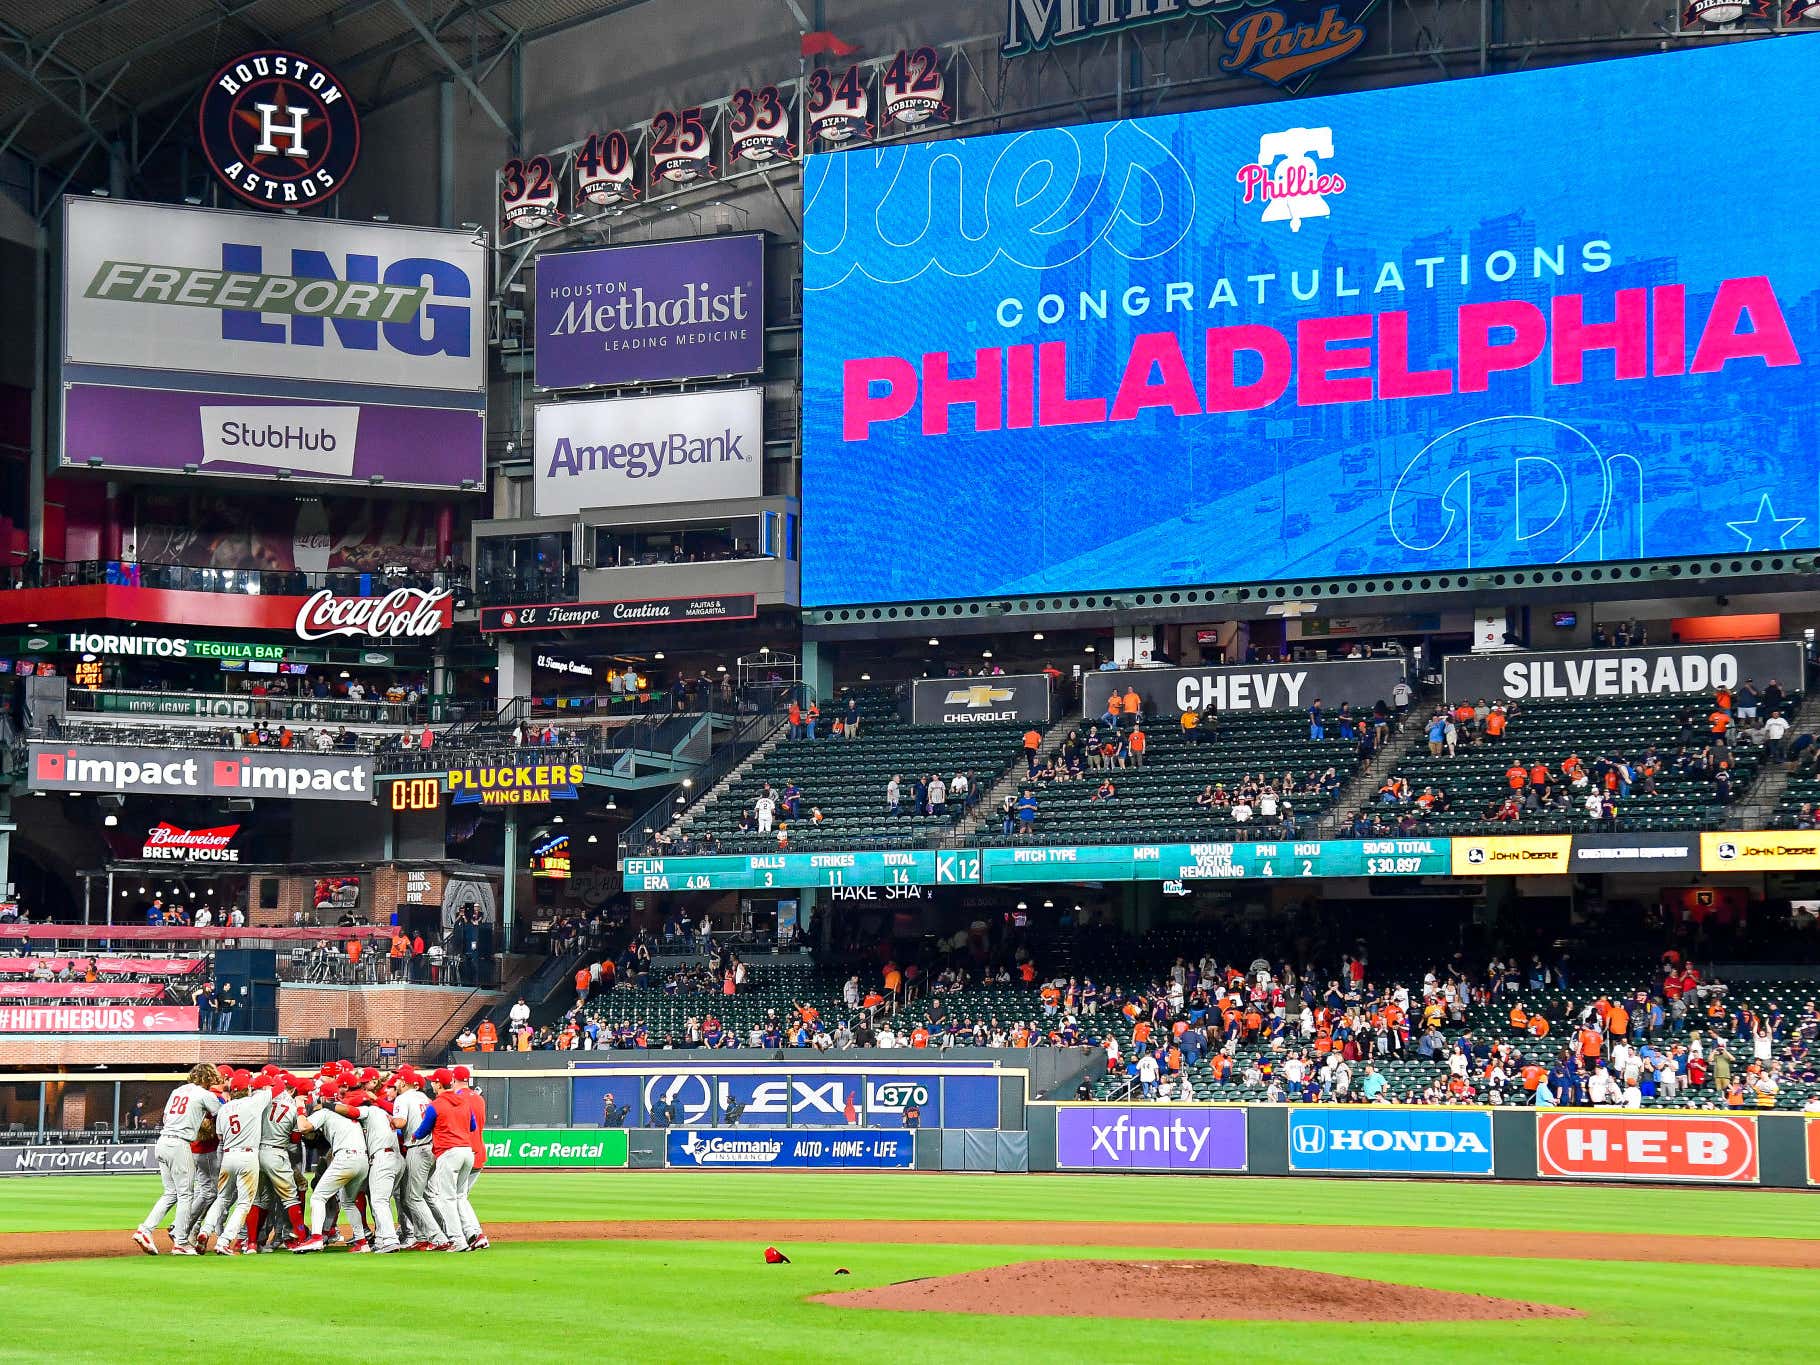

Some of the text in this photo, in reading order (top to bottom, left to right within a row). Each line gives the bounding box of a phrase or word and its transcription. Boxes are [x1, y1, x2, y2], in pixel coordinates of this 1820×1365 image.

[1222, 8, 1364, 80] Park
[219, 57, 342, 104] HOUSTON
[883, 46, 940, 96] 42
[807, 64, 862, 113] 34
[729, 86, 782, 133] 33
[254, 101, 309, 158] H
[650, 106, 705, 155] 25
[575, 130, 629, 178] 40
[225, 161, 334, 201] ASTROS
[502, 154, 552, 203] 32
[1236, 164, 1346, 203] Phillies
[97, 264, 418, 319] FREEPORT
[550, 281, 627, 298] HOUSTON
[996, 240, 1613, 328] CONGRATULATIONS
[222, 243, 471, 358] LNG
[550, 282, 749, 337] Methodist
[604, 329, 748, 352] LEADING MEDICINE
[843, 275, 1802, 442] PHILADELPHIA
[221, 421, 337, 452] StubHub
[295, 587, 454, 641] Coca-Cola
[520, 603, 671, 625] El Tiempo Cantina
[685, 607, 726, 616] MARGARITAS
[690, 601, 715, 609] FAJITAS
[70, 633, 284, 658] HORNITOS TEQUILA BAR
[1503, 653, 1738, 699] SILVERADO
[1176, 672, 1308, 712] CHEVY
[943, 711, 1018, 723] CHEVROLET
[66, 749, 198, 788] impact
[240, 756, 367, 795] impact
[448, 764, 585, 790] PLUCKERS
[392, 780, 437, 810] 0:00
[482, 789, 550, 804] WING BAR
[149, 827, 229, 847] Budweiser
[1363, 841, 1435, 854] 50/50 TOTAL
[143, 846, 239, 862] BREW HOUSE
[1014, 847, 1160, 862] PITCH TYPE MPH
[1190, 843, 1234, 856] MOUND
[1256, 843, 1320, 857] PHI HOU
[1489, 850, 1558, 861] JOHN DEERE
[1742, 845, 1816, 857] JOHN DEERE
[628, 860, 664, 874] EFLIN
[751, 853, 916, 869] BALLS STRIKES TOTAL
[937, 857, 980, 882] K 12
[1180, 865, 1245, 878] REMAINING
[1196, 856, 1232, 867] VISITS
[1262, 860, 1313, 876] 4 2
[408, 872, 425, 881] THIS
[643, 875, 711, 889] ERA 4.04
[764, 869, 909, 886] 3 11 14
[407, 892, 423, 902] FOR
[0, 1008, 135, 1030] #HITTHEBUDS
[169, 1095, 189, 1115] 28
[885, 1086, 928, 1106] 370
[269, 1101, 290, 1124] 17
[229, 1114, 241, 1135] 5
[709, 1137, 781, 1154] Germania
[1091, 1114, 1211, 1162] xfinity
[1329, 1129, 1489, 1153] HONDA
[1565, 1128, 1730, 1166] H-E-B
[16, 1149, 150, 1169] NITTOTIRE.COM
[518, 1142, 547, 1158] Car
[551, 1142, 604, 1158] Rental
[714, 1153, 770, 1161] INSURANCE
[793, 1141, 898, 1158] AUTO HOME LIFE
